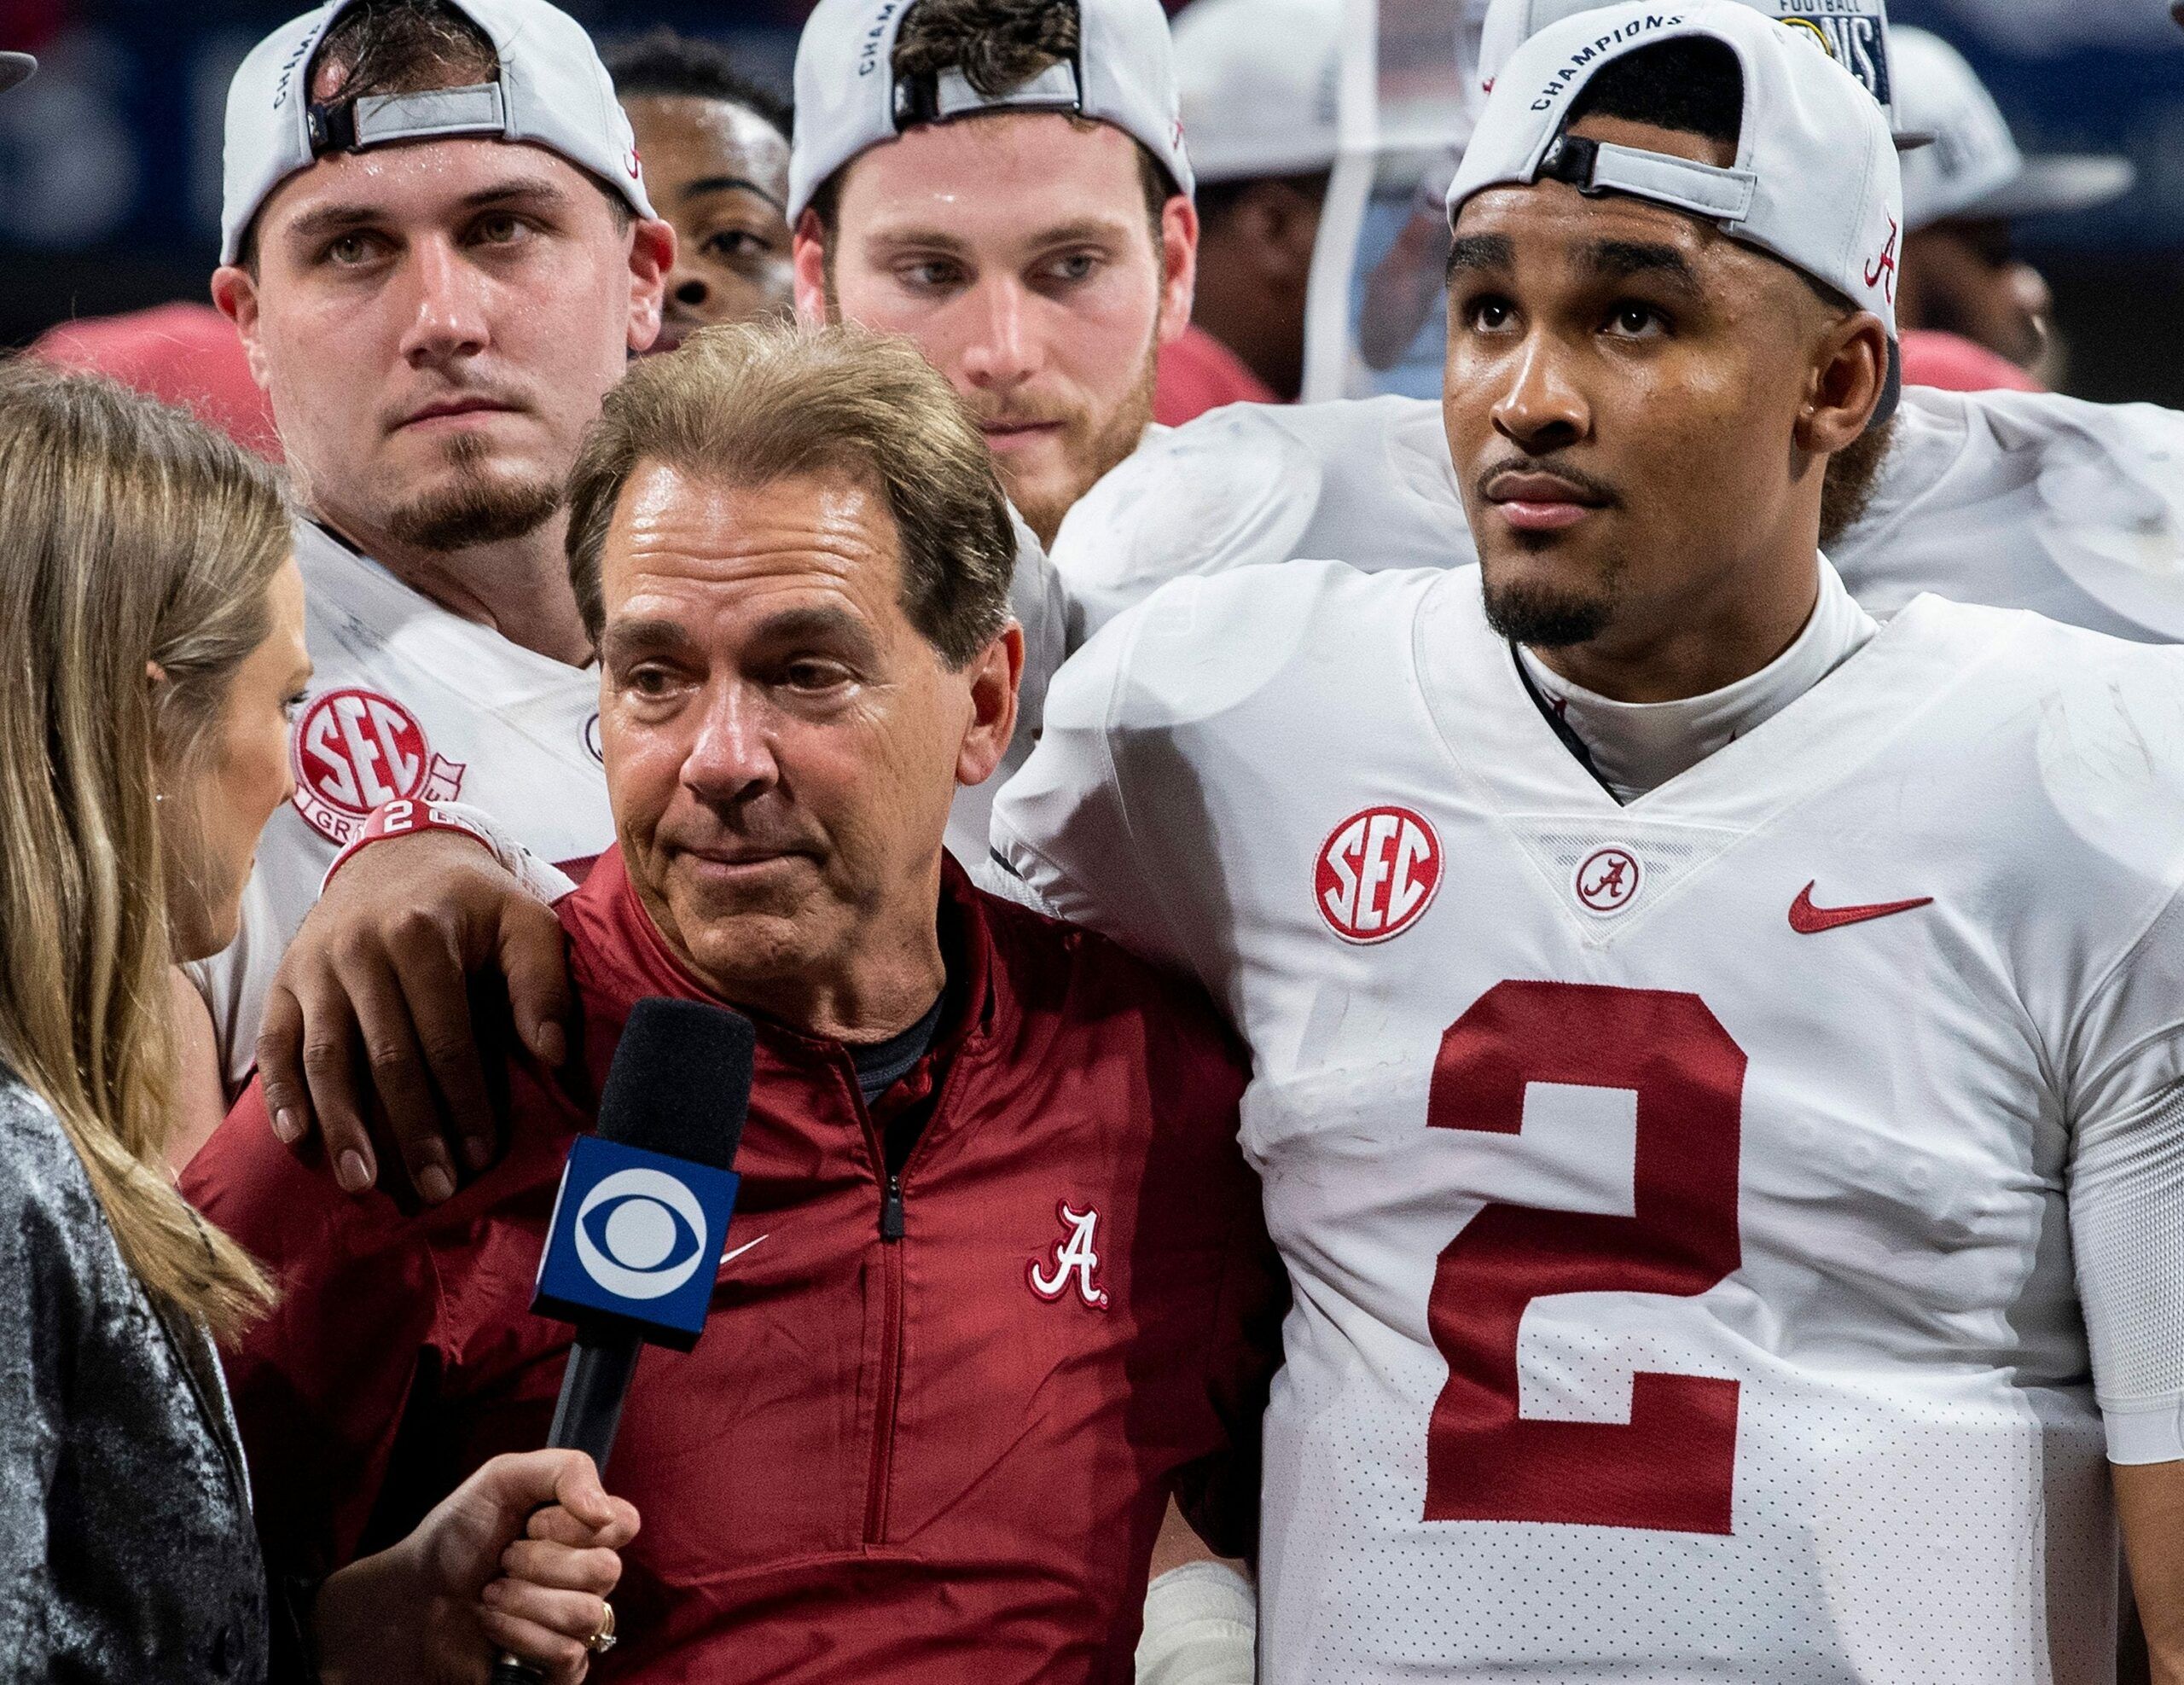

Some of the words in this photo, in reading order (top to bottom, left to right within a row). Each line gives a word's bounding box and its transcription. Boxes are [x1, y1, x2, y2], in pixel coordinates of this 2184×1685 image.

[1531, 15, 1685, 111] CHAMPIONS
[305, 695, 420, 808] SEC
[384, 799, 413, 833] 2
[1323, 814, 1431, 931] SEC
[1584, 858, 1627, 898] A
[1029, 1201, 1103, 1304] A
[1422, 979, 1748, 1536] 2
